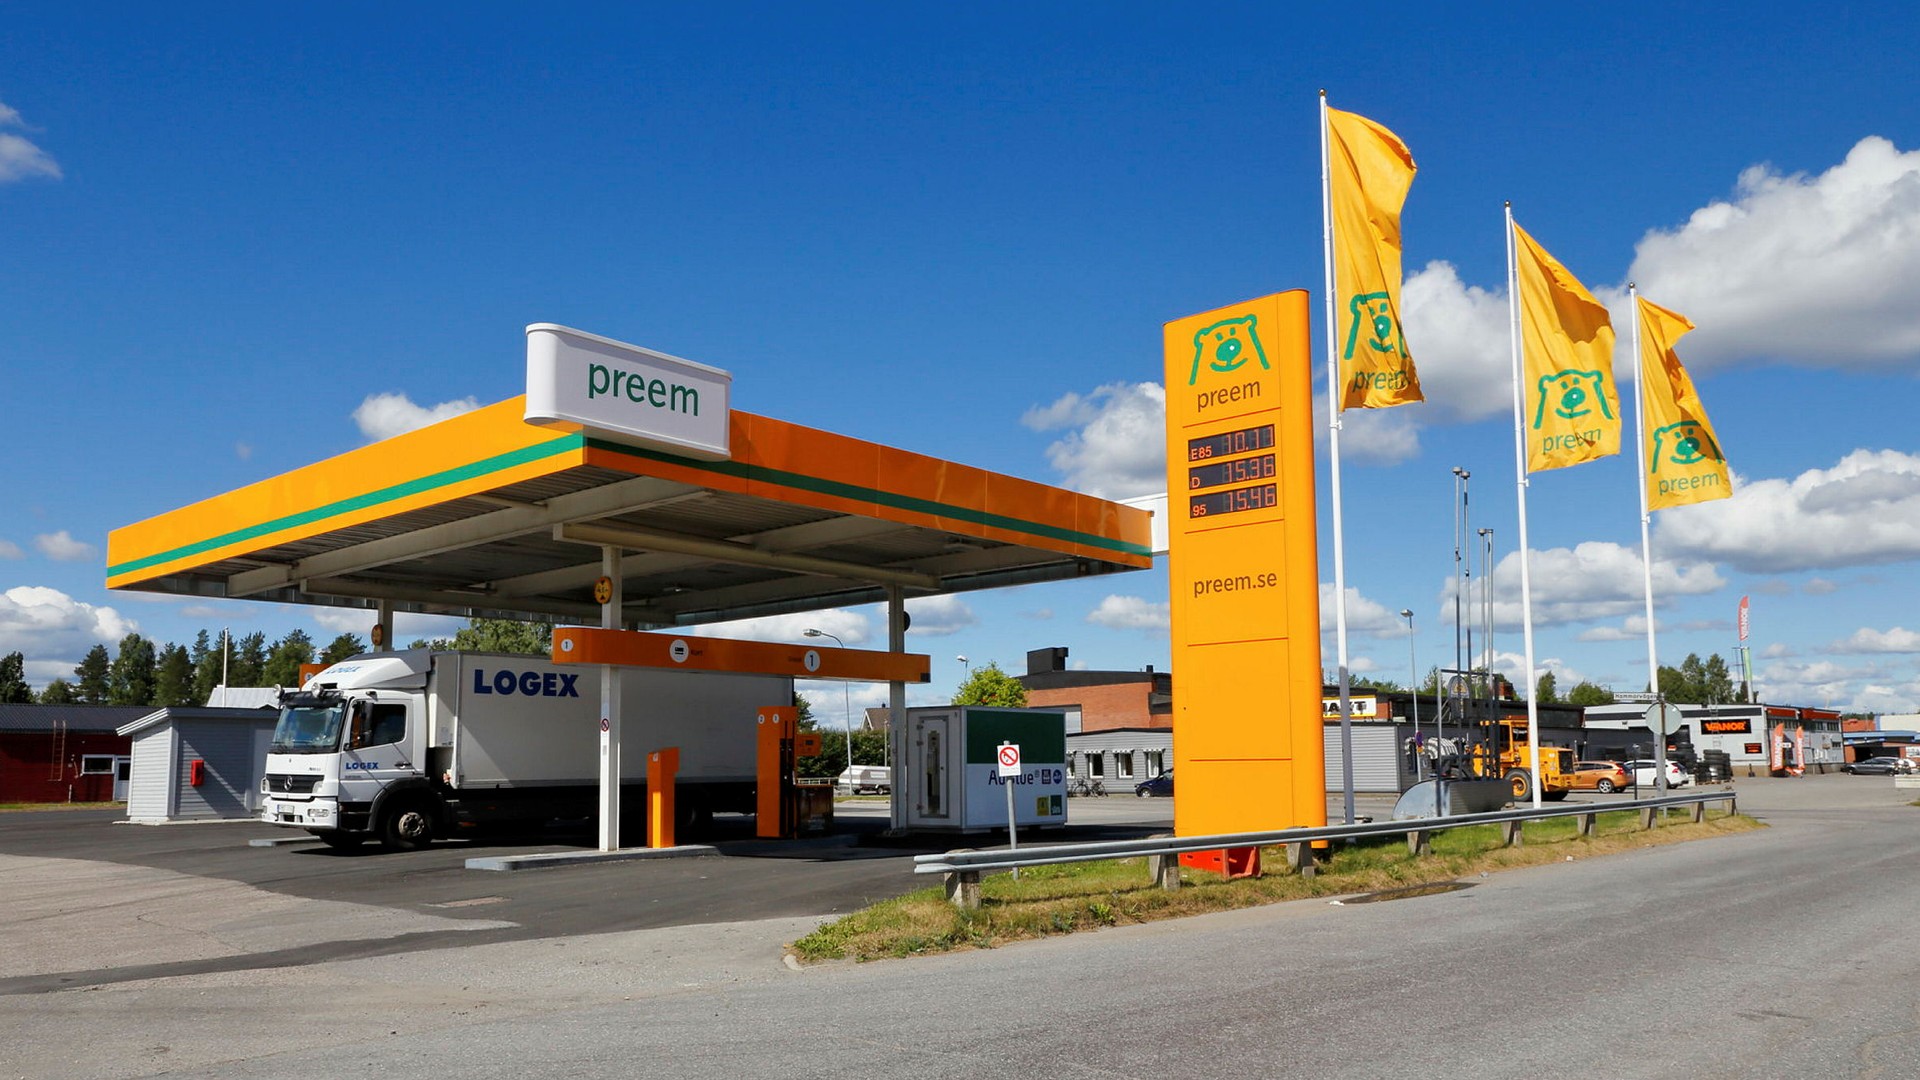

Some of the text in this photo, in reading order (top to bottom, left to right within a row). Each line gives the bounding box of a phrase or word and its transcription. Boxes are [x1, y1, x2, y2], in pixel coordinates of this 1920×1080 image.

[588, 363, 698, 416] preem
[1197, 381, 1260, 413] preem
[1191, 445, 1212, 460] E85
[1191, 455, 1275, 488] D 15.36
[1658, 473, 1719, 496] preem
[1192, 485, 1276, 516] 95 15.46
[1194, 573, 1277, 598] preem.se
[473, 668, 580, 698] LOGEX
[345, 762, 379, 770] LOGEX
[988, 769, 1034, 785] Adlue
